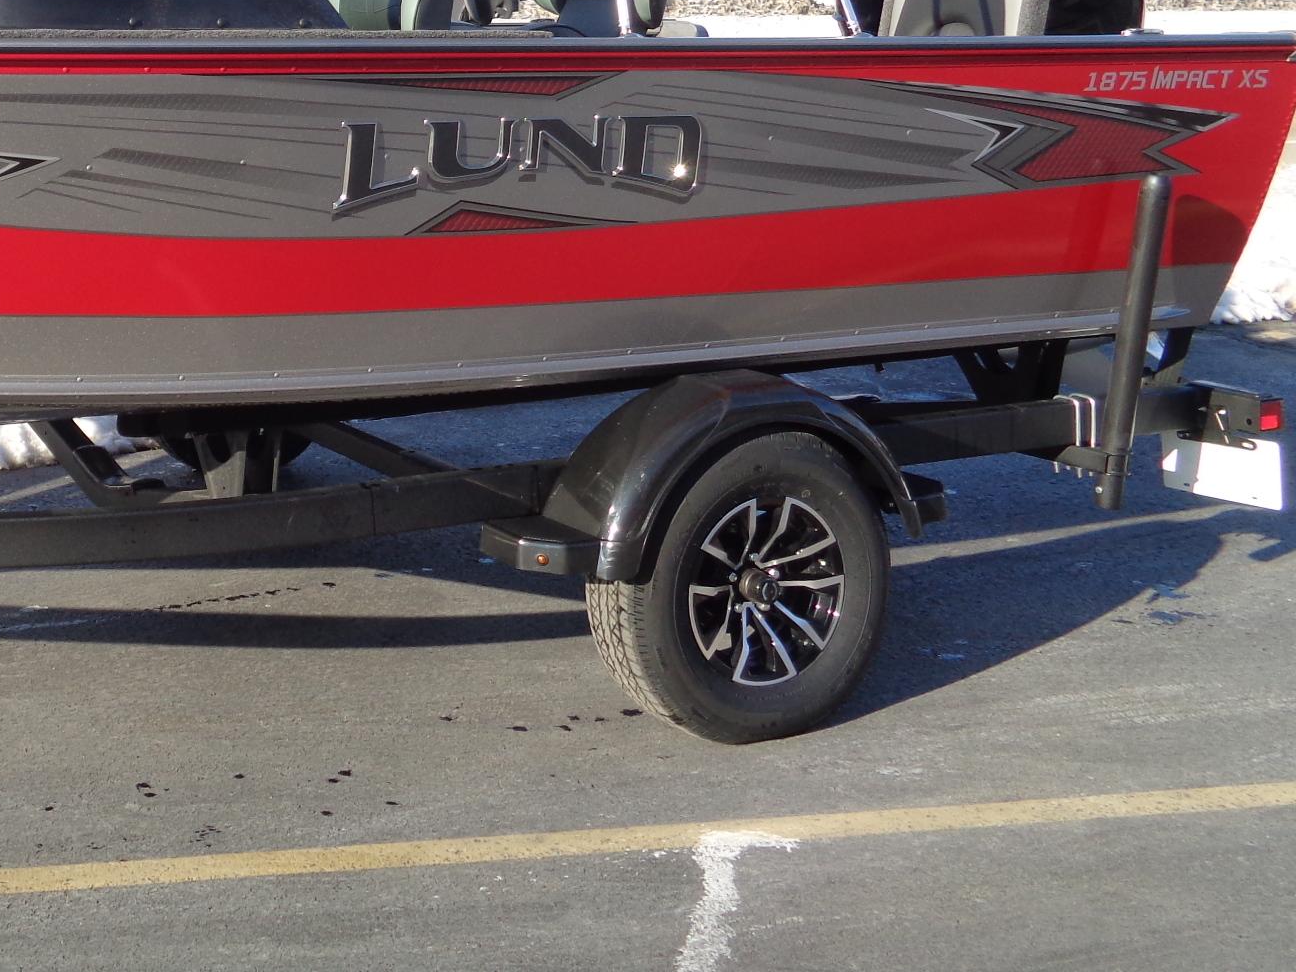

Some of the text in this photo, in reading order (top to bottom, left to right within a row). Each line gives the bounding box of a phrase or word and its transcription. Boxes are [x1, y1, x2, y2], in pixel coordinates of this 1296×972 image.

[1083, 65, 1269, 92] 1875 IMPACT XS
[332, 114, 703, 210] LUND
